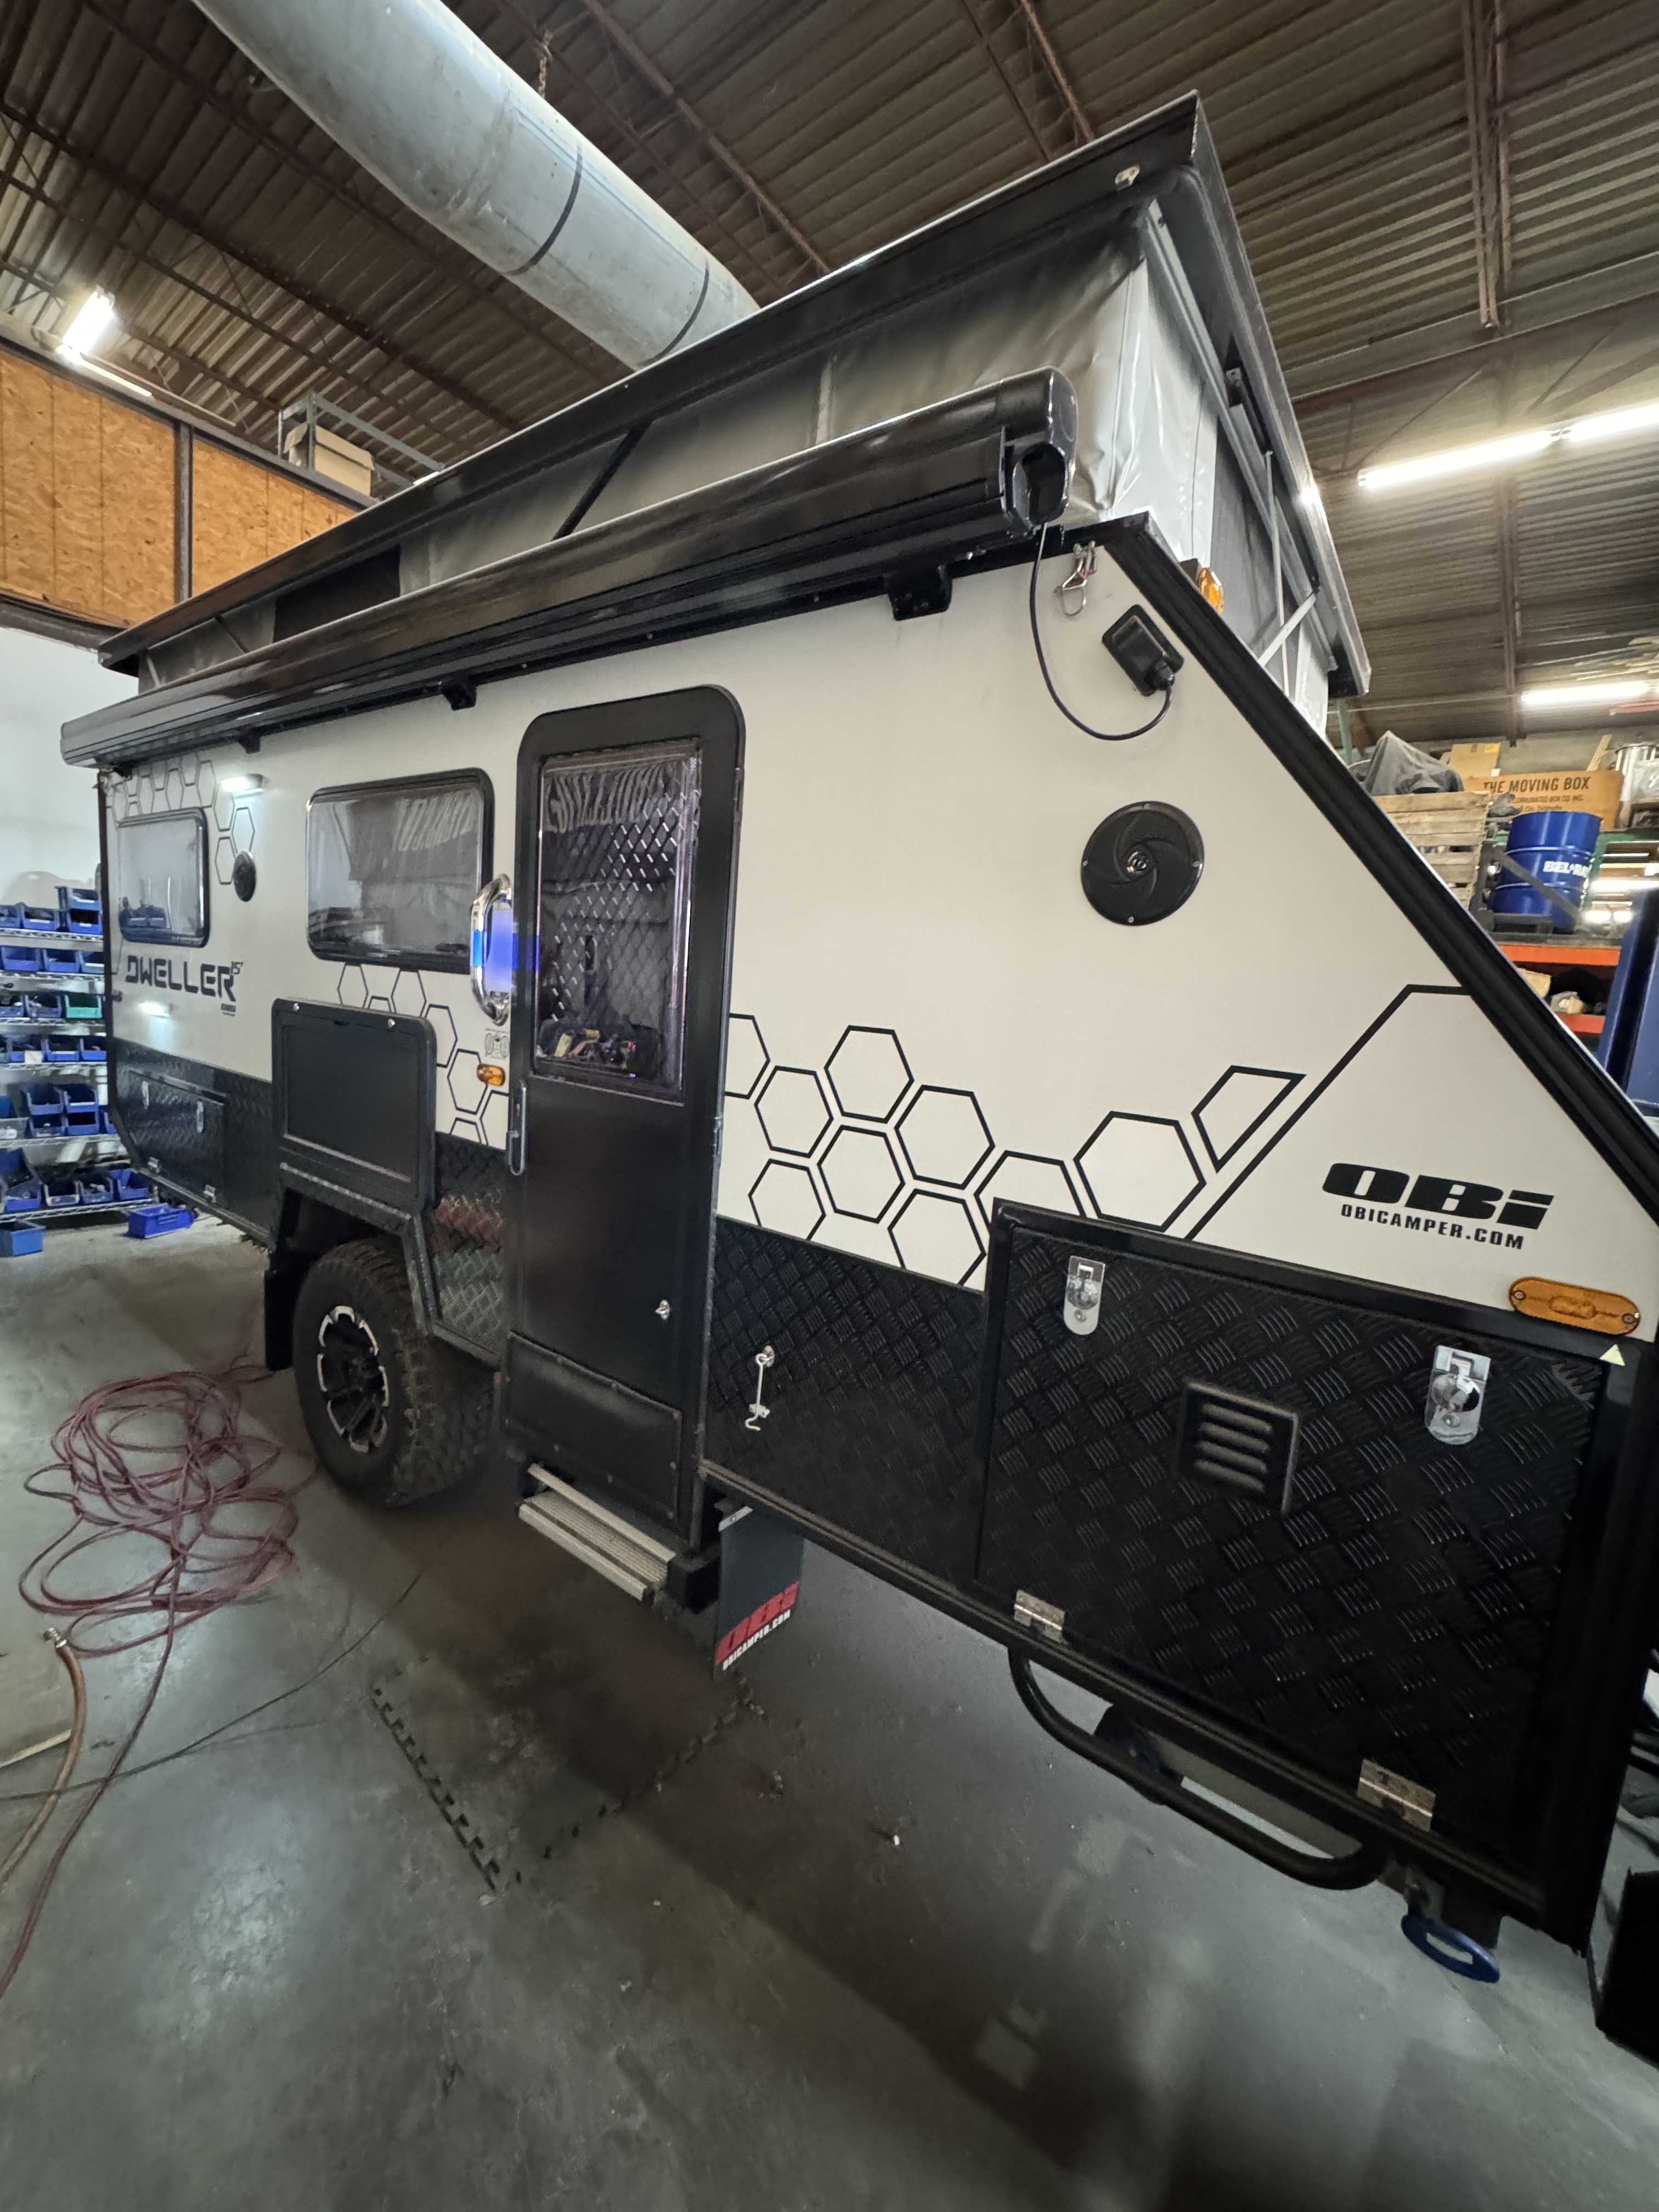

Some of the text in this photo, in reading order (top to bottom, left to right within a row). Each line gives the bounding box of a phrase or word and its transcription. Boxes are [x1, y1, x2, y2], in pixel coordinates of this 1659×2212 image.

[1483, 776, 1590, 794] THE MOVING BOX
[125, 955, 236, 1002] DWELLER
[1341, 1204, 1523, 1249] OBICAMPER.COM
